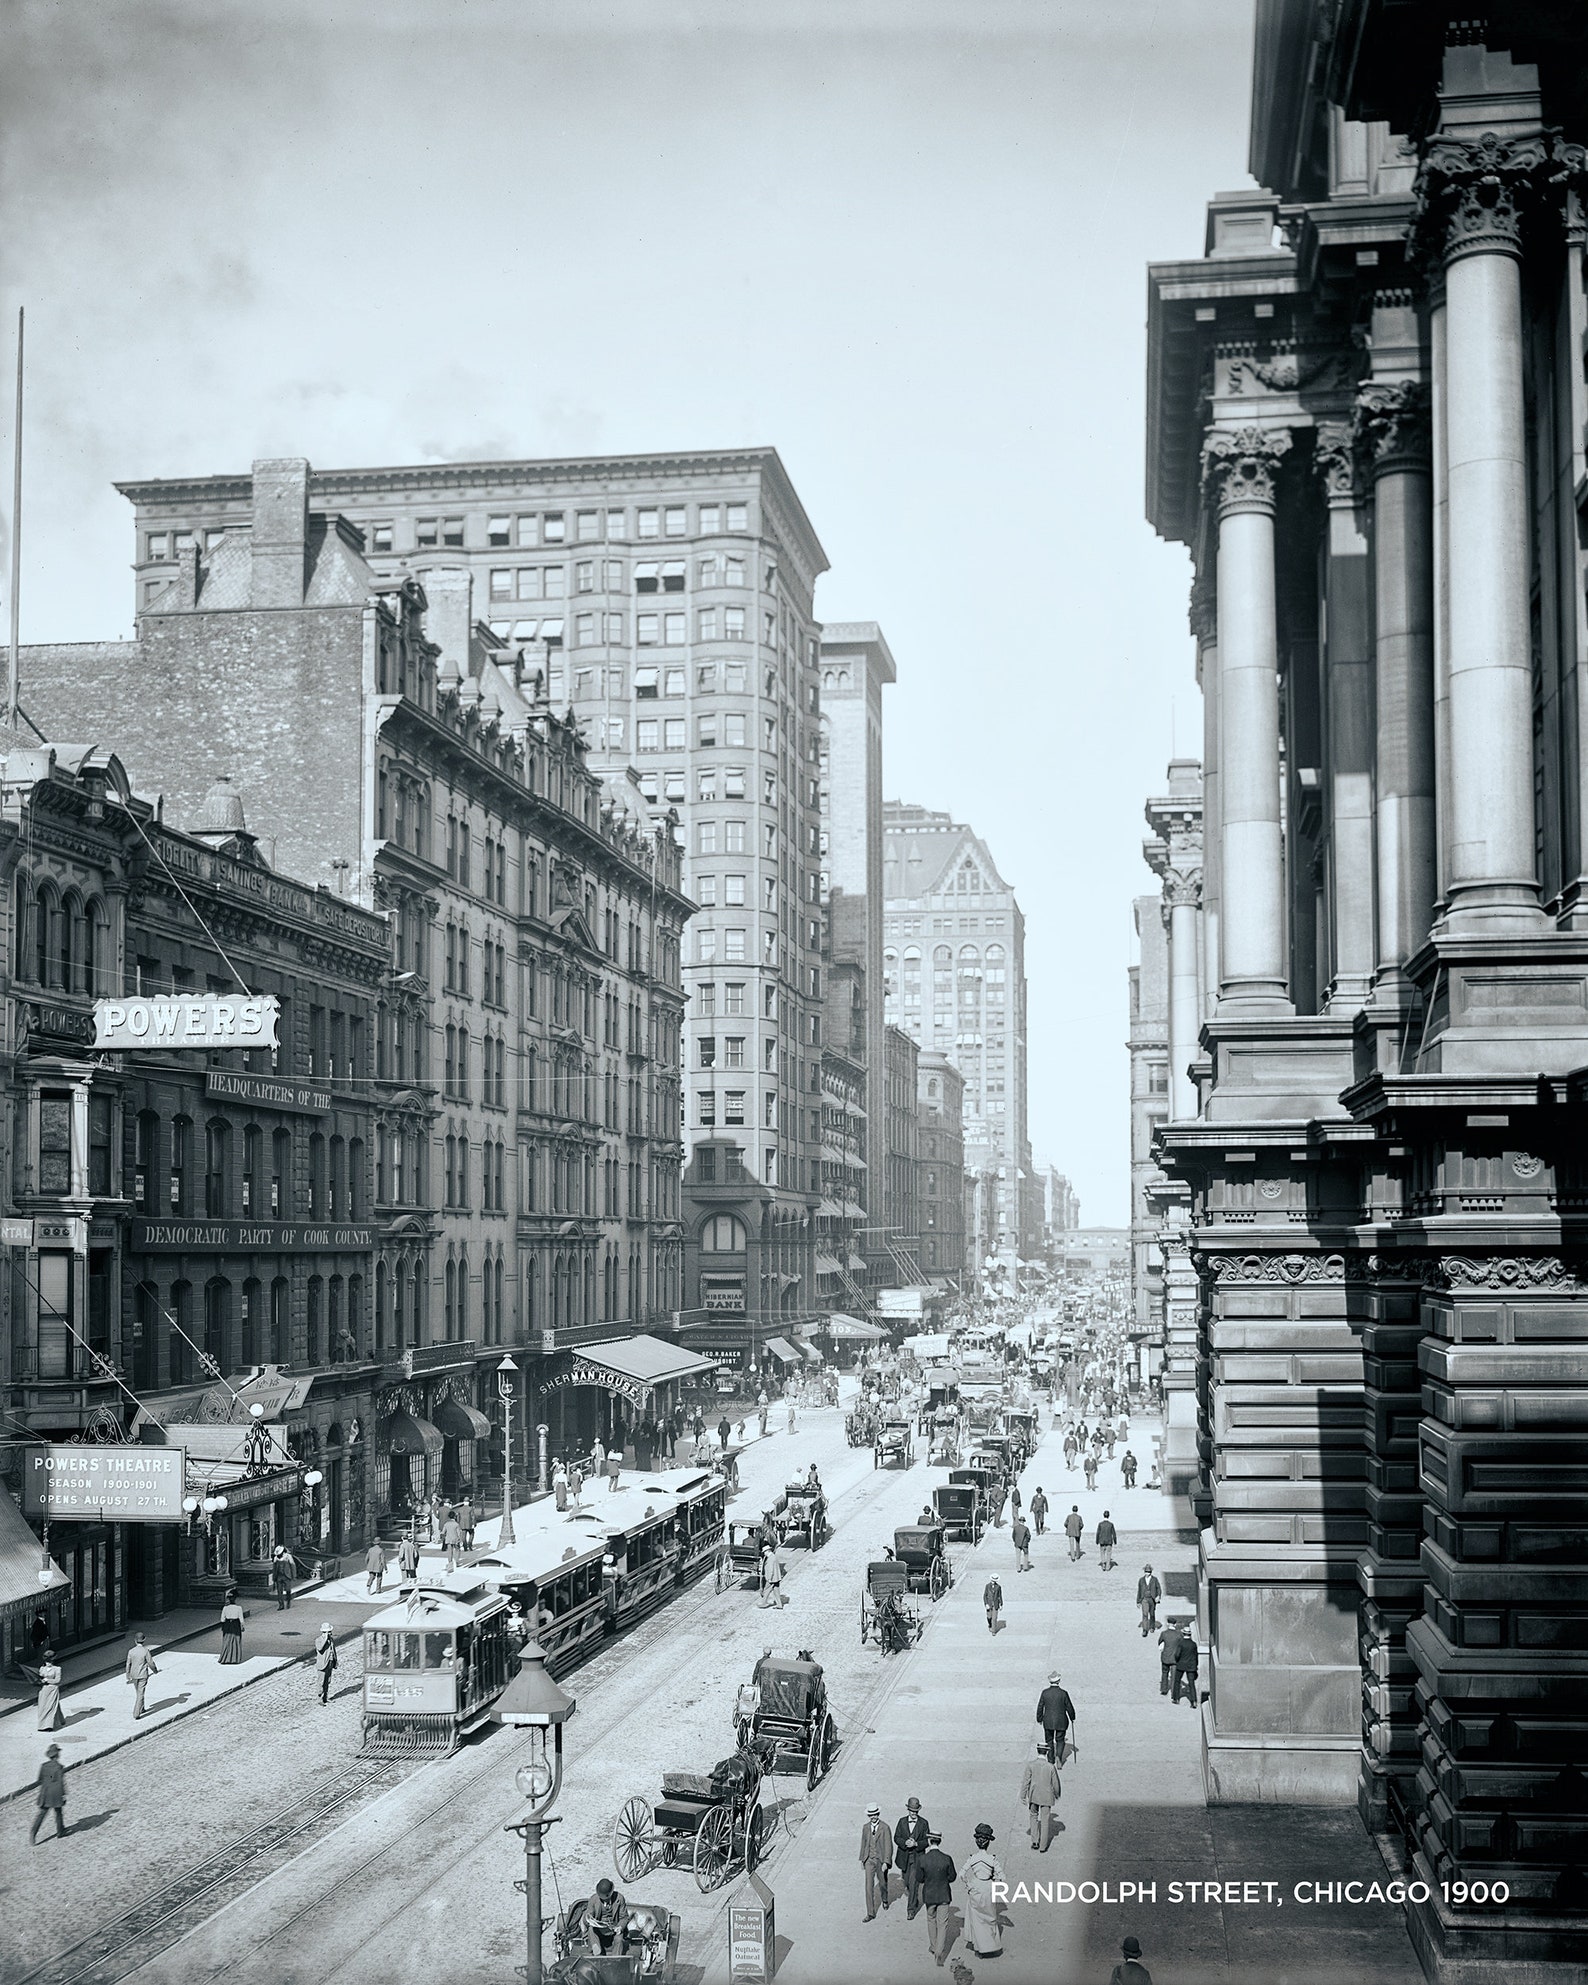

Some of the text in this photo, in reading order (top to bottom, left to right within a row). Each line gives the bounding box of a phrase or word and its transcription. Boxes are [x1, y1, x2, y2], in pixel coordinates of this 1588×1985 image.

[220, 860, 265, 893] SAVINGS
[325, 907, 343, 929] SAFE
[103, 1000, 271, 1036] POWERS'
[138, 1036, 230, 1045] THEATRE
[209, 1073, 331, 1109] HEADQUARTERS OF THE
[145, 1226, 229, 1244] DEMOCRATIC
[238, 1228, 274, 1244] PARTY
[281, 1229, 296, 1244] OF
[303, 1230, 329, 1245] COOK
[706, 1301, 742, 1309] BANK
[1128, 1323, 1163, 1333] DENTIS
[539, 1370, 638, 1397] SHERMAN HOUSE
[106, 1458, 171, 1472] THEATRE
[48, 1478, 157, 1489] SEASON 1900-1901
[39, 1494, 78, 1504] OPENS
[84, 1495, 128, 1506] AUGUST
